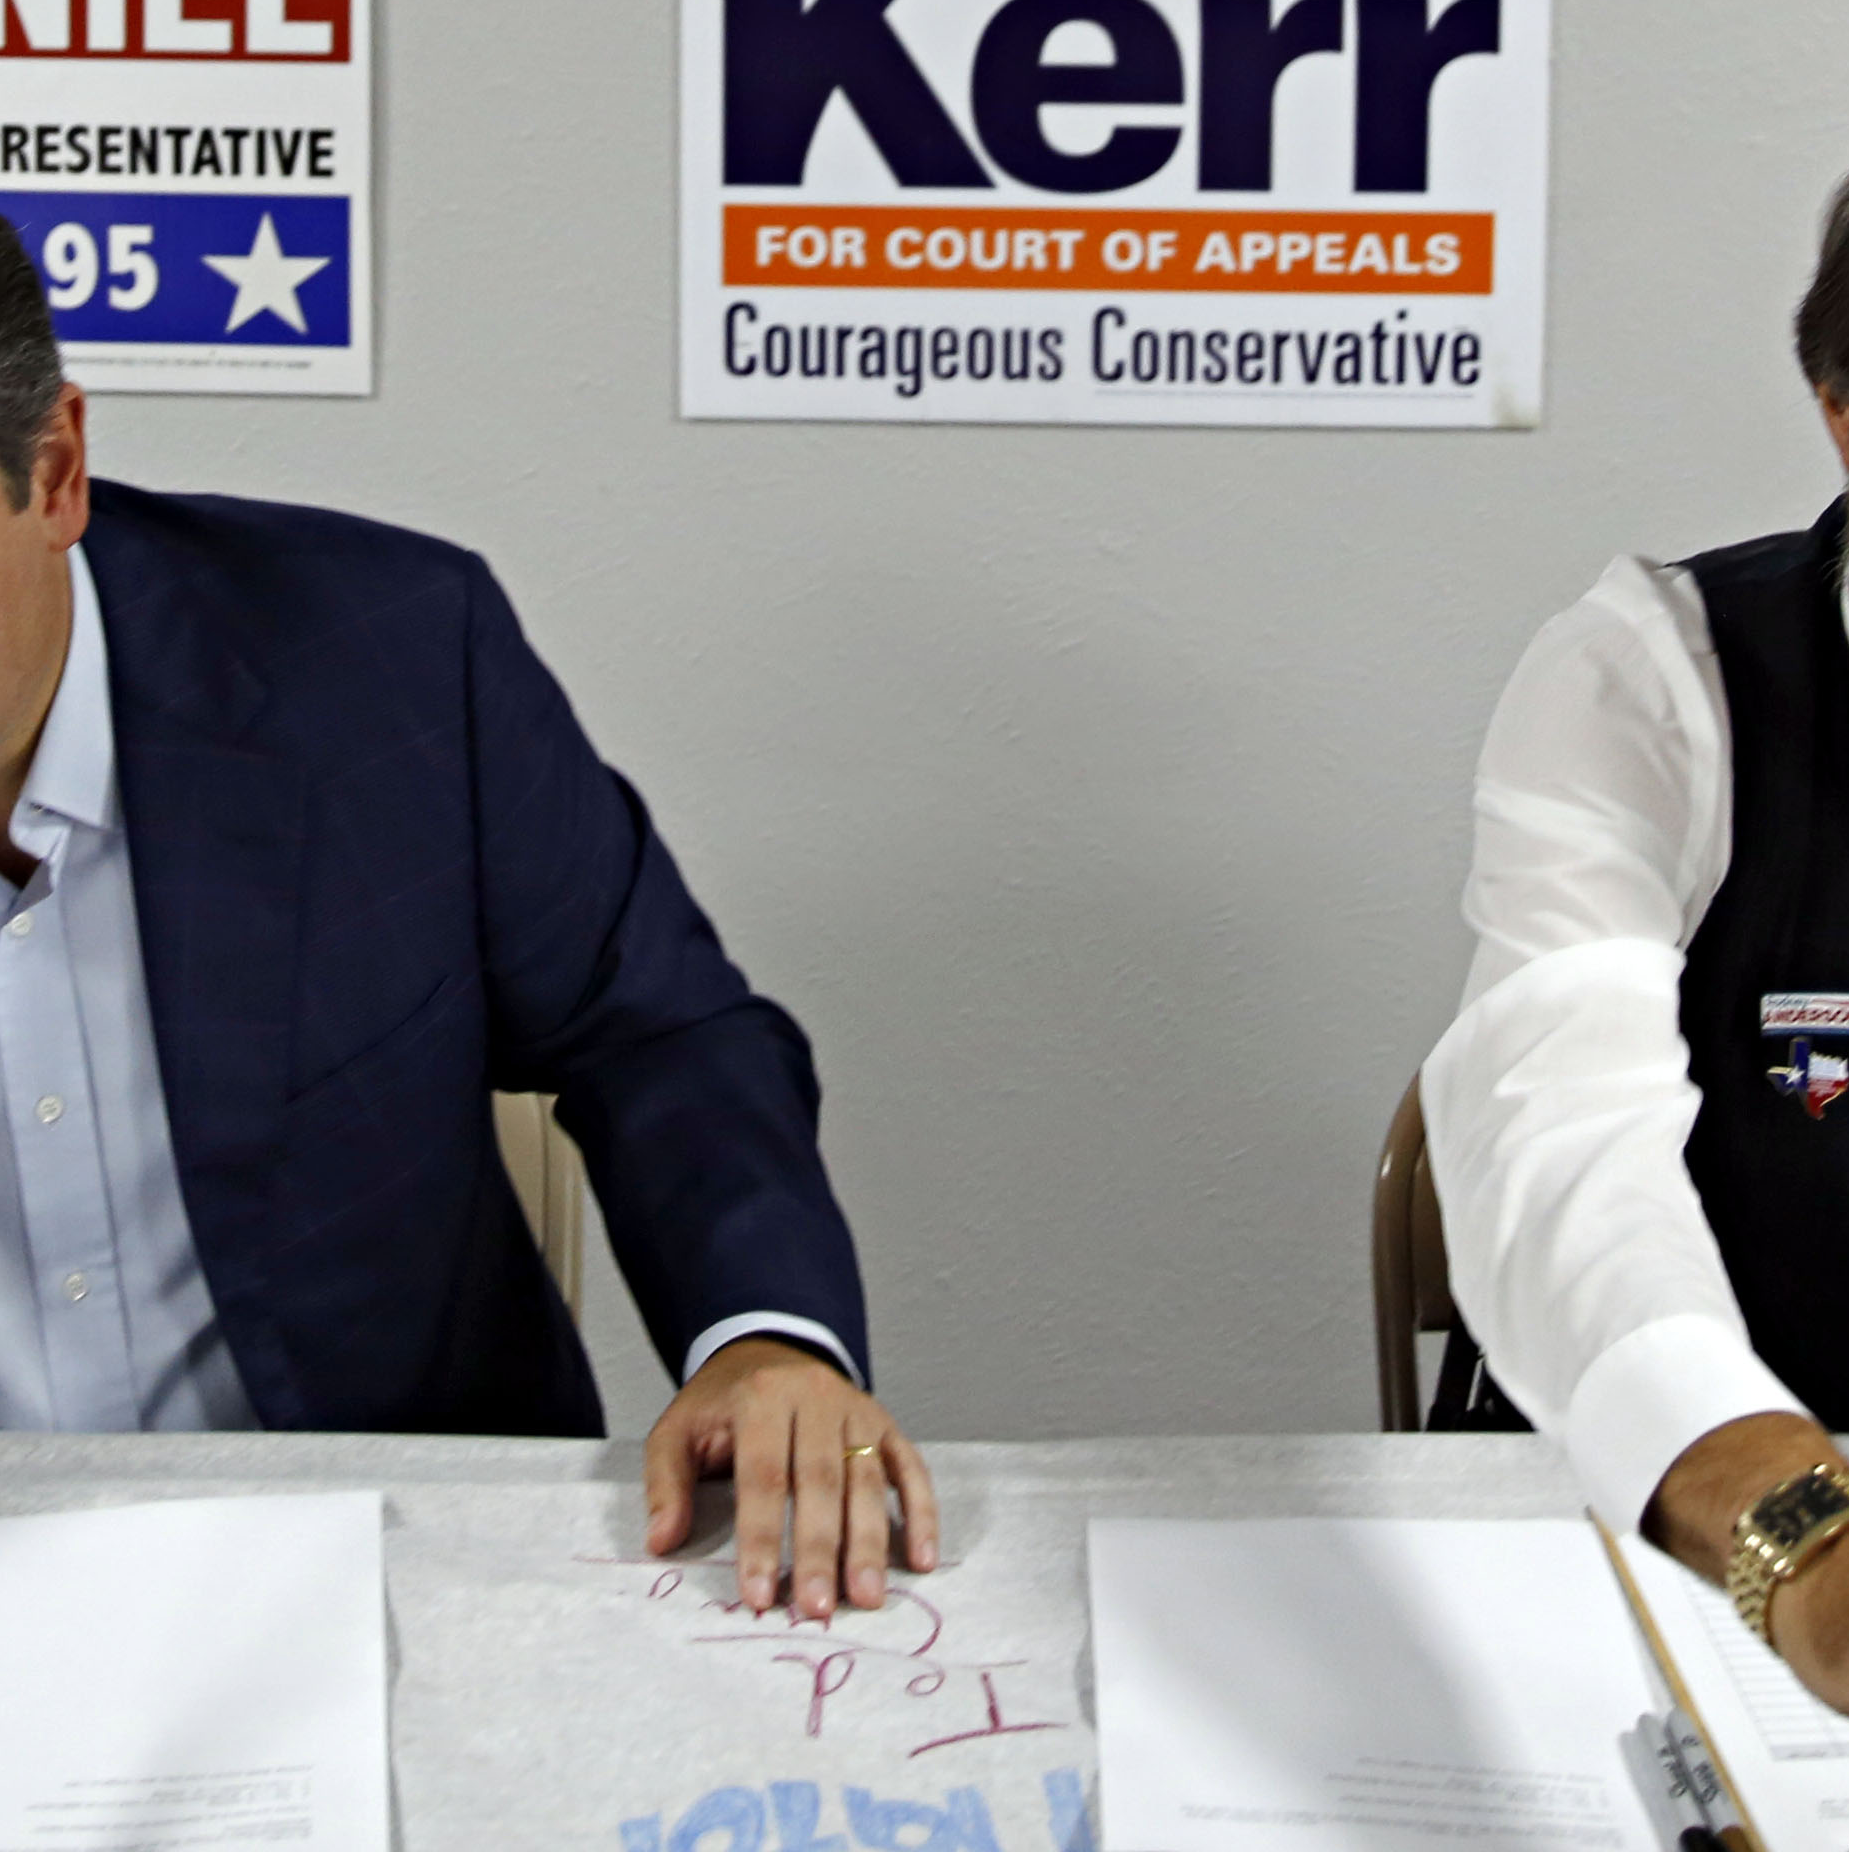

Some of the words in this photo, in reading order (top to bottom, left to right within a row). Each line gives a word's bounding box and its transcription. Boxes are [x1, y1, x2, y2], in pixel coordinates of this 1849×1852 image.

[44, 224, 159, 311] 95
[756, 226, 865, 268] FOR
[885, 228, 1086, 271] COURT
[1103, 231, 1177, 273] OF
[1195, 233, 1461, 275] APPEALS
[724, 302, 1064, 397] Courageous
[1094, 308, 1480, 388] Conservative
